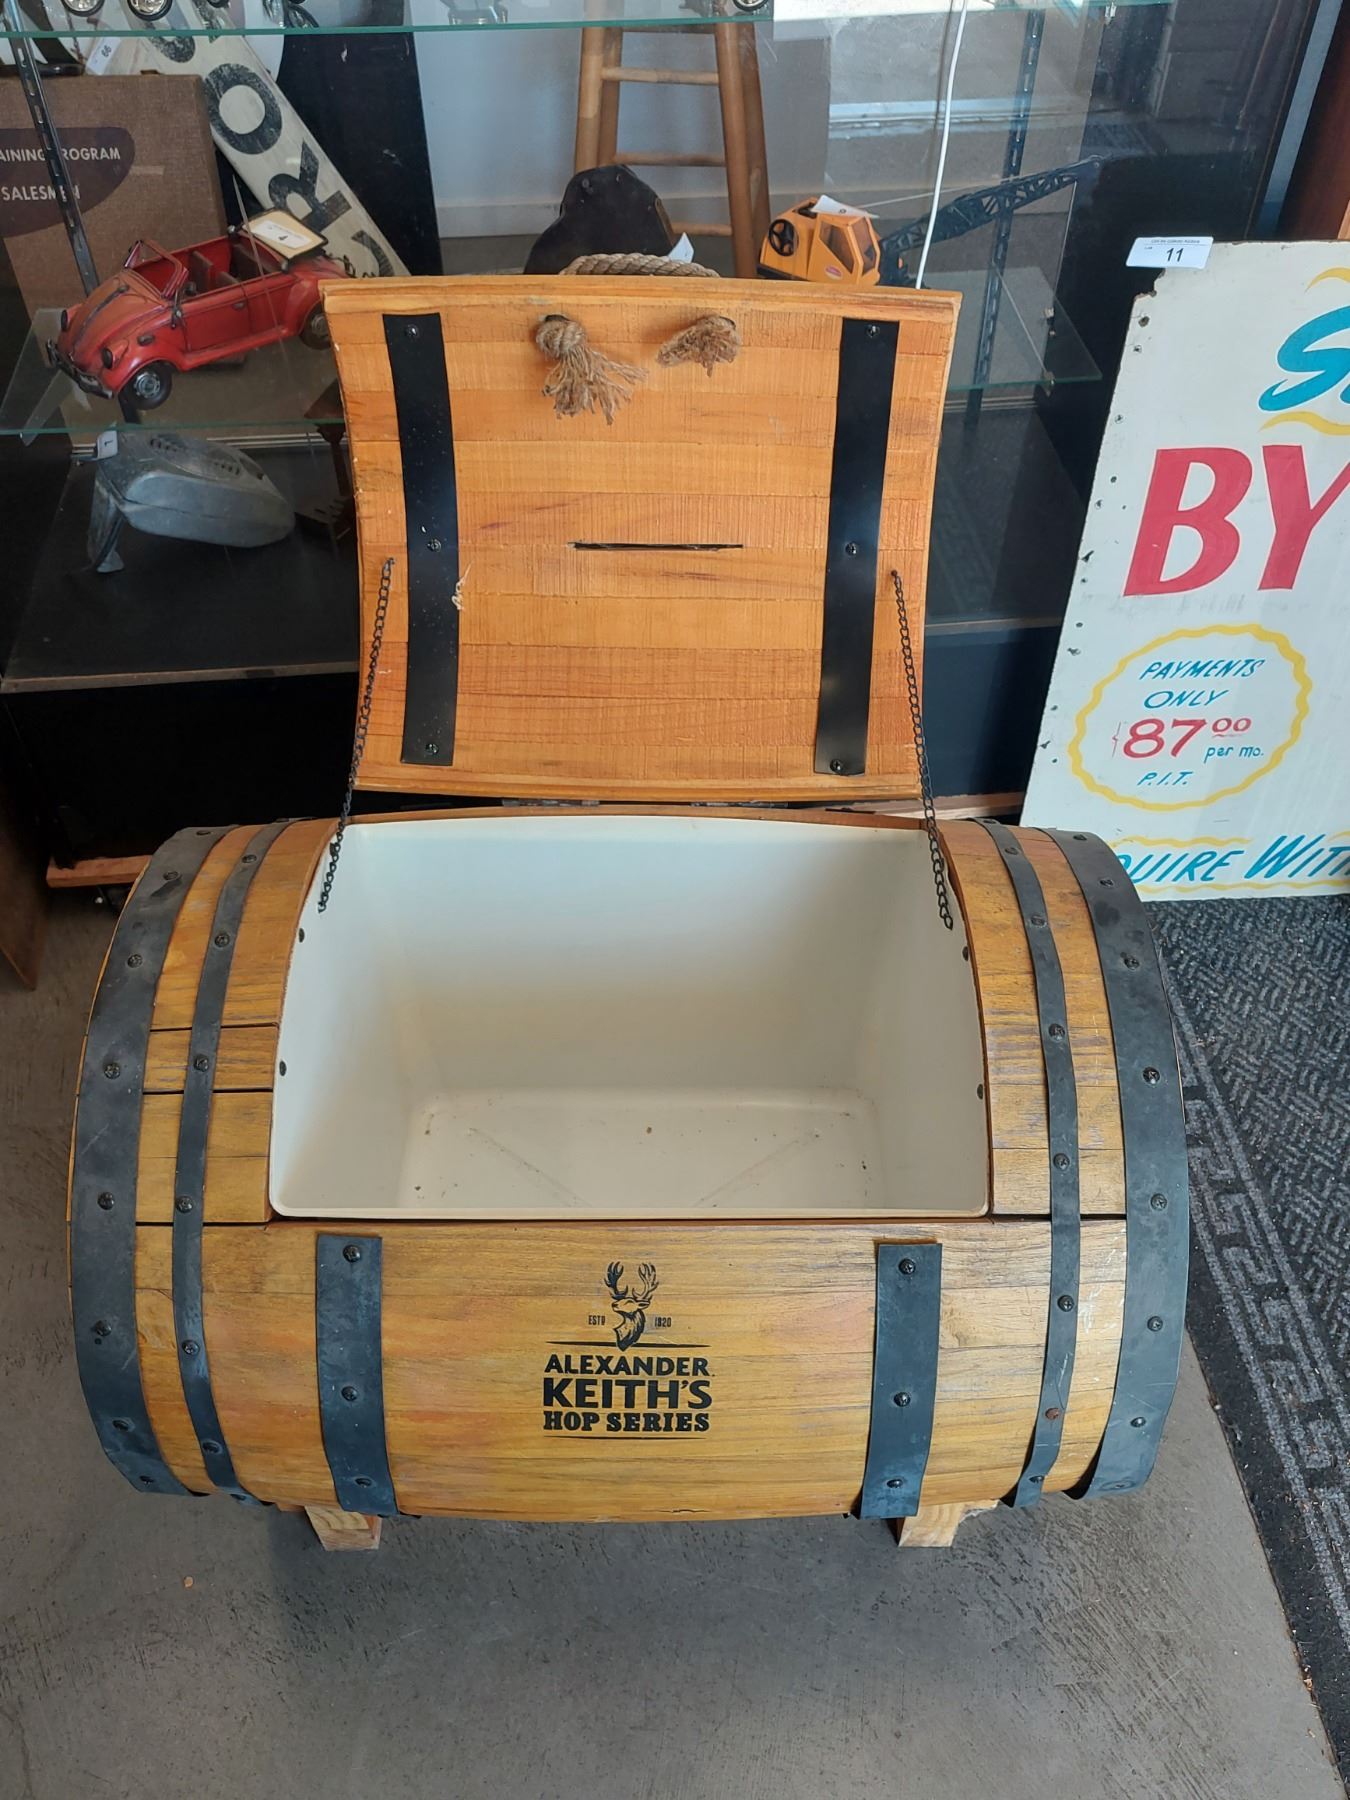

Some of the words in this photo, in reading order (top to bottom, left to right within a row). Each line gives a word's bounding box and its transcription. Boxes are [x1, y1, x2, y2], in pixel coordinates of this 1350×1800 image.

[61, 147, 121, 161] ROGRAM
[1166, 247, 1184, 262] 11
[1123, 443, 1350, 597] BY
[1139, 658, 1265, 681] PAYMENTS
[1144, 689, 1229, 709] ONLY
[1203, 746, 1233, 764] per
[1238, 746, 1264, 758] mo.
[1137, 771, 1193, 786] P.I.T.
[544, 1353, 710, 1377] ALEXANDER
[543, 1377, 713, 1410] KEITH'S
[543, 1410, 600, 1432] HOP
[606, 1412, 710, 1432] SERIES
